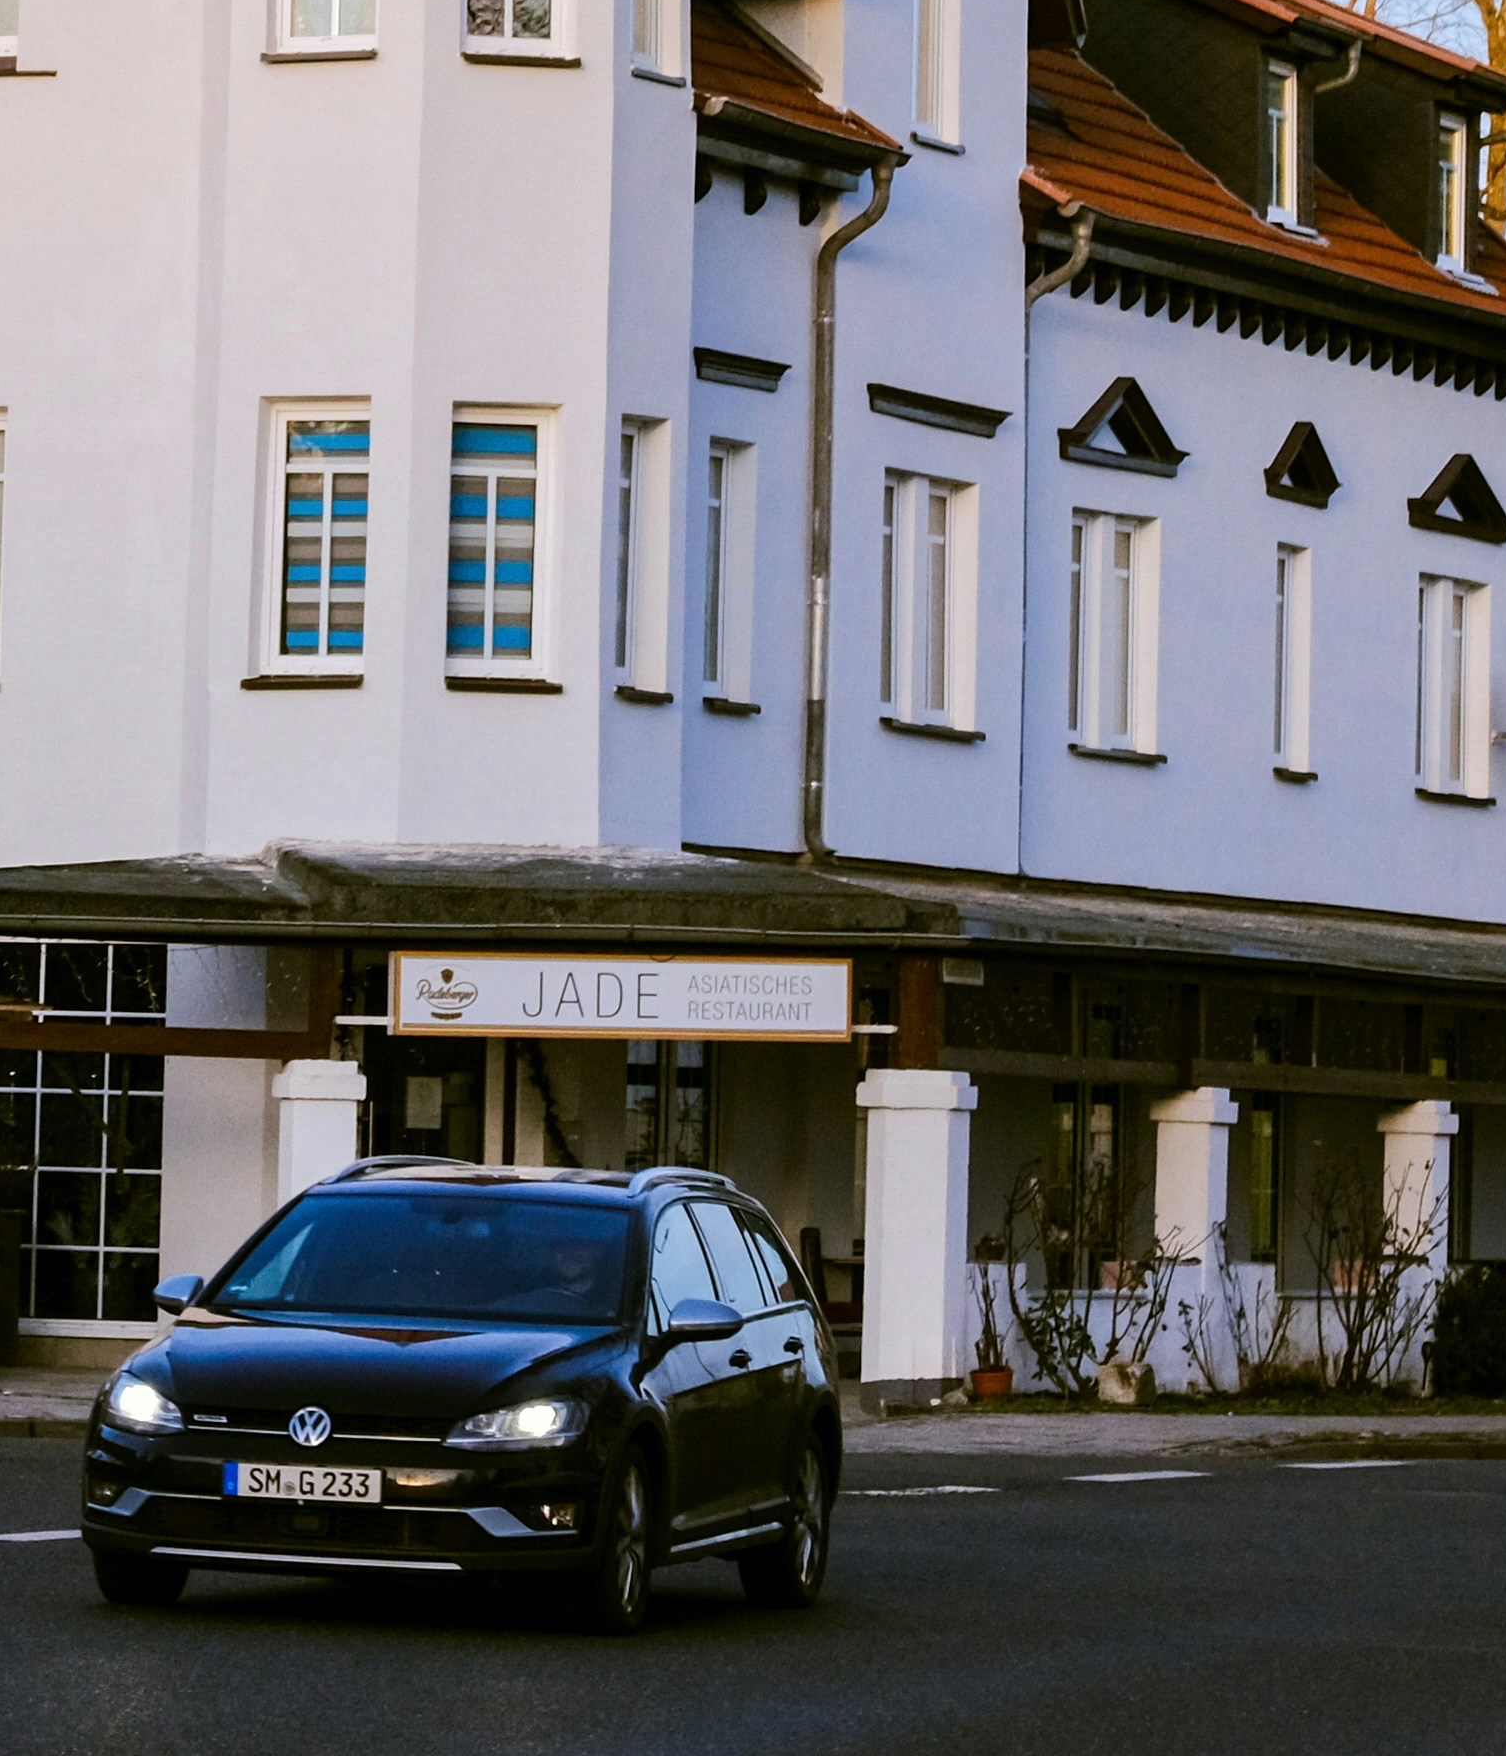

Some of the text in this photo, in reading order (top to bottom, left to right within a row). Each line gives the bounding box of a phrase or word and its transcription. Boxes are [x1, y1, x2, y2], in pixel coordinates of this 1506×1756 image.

[522, 971, 660, 1019] JADE
[687, 974, 813, 996] ASIATISCHES
[687, 1000, 813, 1022] RESTAURANT
[248, 1467, 370, 1498] SM G 233
